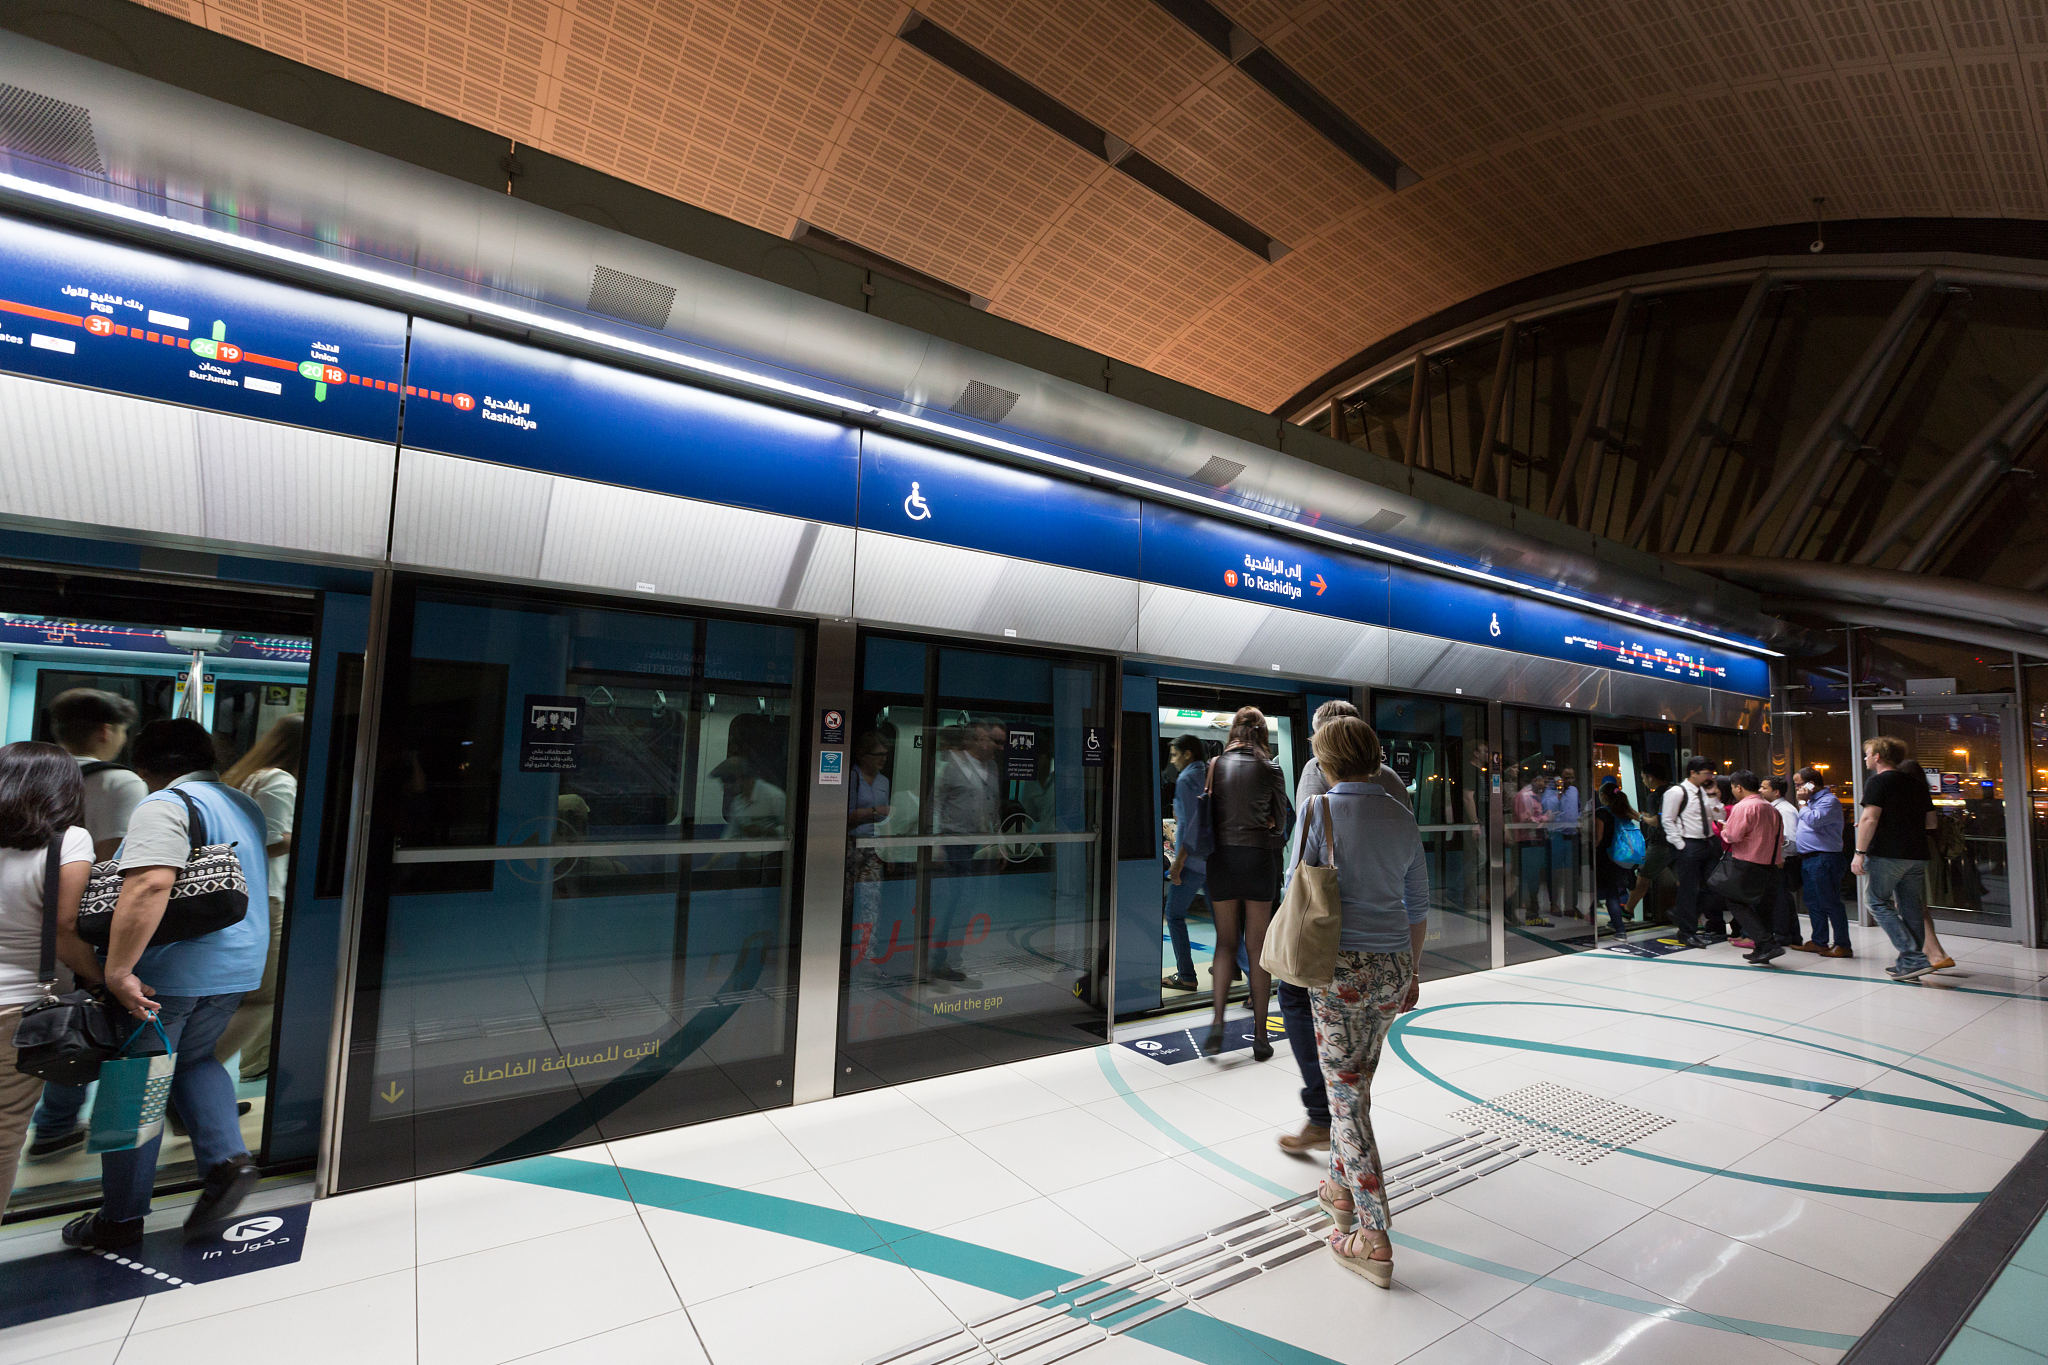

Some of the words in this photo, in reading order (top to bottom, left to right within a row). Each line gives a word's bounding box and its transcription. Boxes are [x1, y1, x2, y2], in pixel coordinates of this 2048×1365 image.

[90, 301, 114, 314] FGB
[90, 318, 110, 333] 31
[194, 340, 214, 355] 26
[219, 346, 239, 360] 19
[310, 350, 339, 364] Union
[188, 369, 239, 387] BurJuman
[302, 364, 323, 378] 20
[325, 368, 342, 382] 18
[457, 396, 470, 408] 11
[483, 395, 531, 414] الراشدية
[482, 408, 537, 430] Rashidiya
[1244, 553, 1284, 576] الراشدية
[1284, 563, 1302, 581] إلى
[1226, 572, 1235, 584] 11
[1242, 572, 1255, 587] To
[1256, 575, 1302, 600] Rashidiya
[933, 1000, 961, 1015] Mind
[964, 997, 981, 1010] the
[984, 995, 1003, 1011] gap
[541, 1045, 619, 1072] للمسافة
[623, 1039, 660, 1061] إنتبه
[462, 1058, 536, 1085] الفاصلة
[202, 1250, 223, 1260] In
[232, 1237, 290, 1255] دخول
